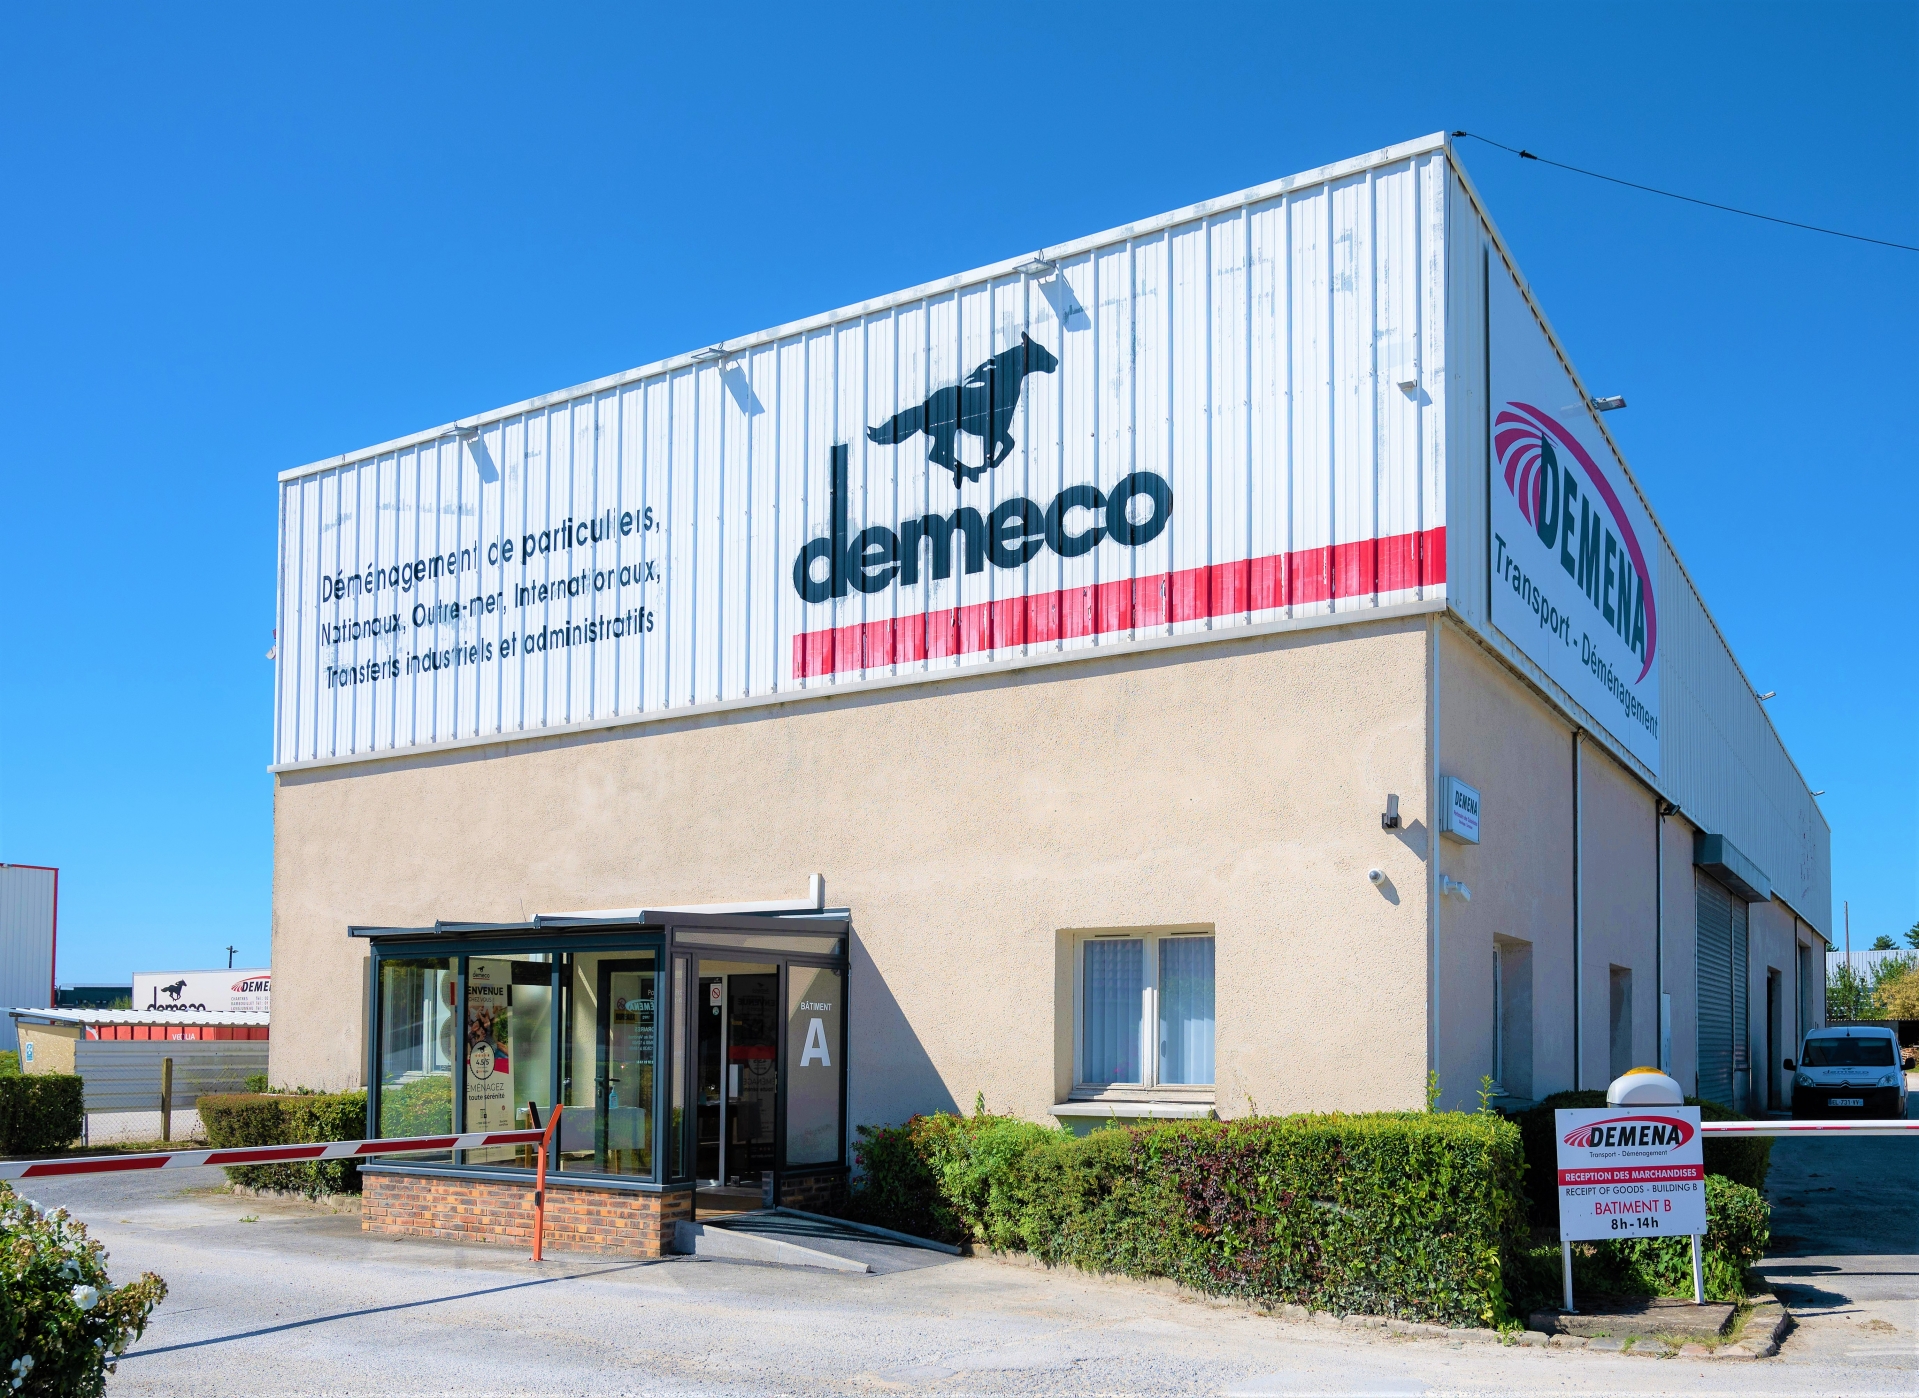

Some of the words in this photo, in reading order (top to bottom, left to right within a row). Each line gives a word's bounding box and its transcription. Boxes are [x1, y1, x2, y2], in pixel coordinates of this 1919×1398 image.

[793, 444, 1173, 604] demeco
[1537, 432, 1646, 666] DEMENA
[322, 540, 478, 603] Déménagement
[487, 534, 514, 566] de
[321, 613, 406, 647] Nationaux,
[412, 591, 507, 628] Outre-mer,
[500, 631, 517, 659] et
[524, 606, 654, 655] administratifs
[1494, 532, 1570, 647] Transport
[1581, 631, 1658, 741] Déménagement
[1454, 790, 1478, 817] DEMENA
[800, 1001, 832, 1011] BÂTIMENT
[800, 1018, 832, 1066] A
[467, 1082, 504, 1092] ÉMÉNAGEZ
[1589, 1125, 1680, 1148] DEMENA
[1565, 1171, 1612, 1182] RECEPTION
[1613, 1171, 1629, 1180] DES
[1632, 1168, 1697, 1179] MARCHANDISES
[1566, 1187, 1596, 1196] RECEIPT
[1599, 1186, 1610, 1195] OF
[1613, 1185, 1644, 1194] GOODS
[1652, 1183, 1690, 1193] BUILDING
[1595, 1200, 1659, 1215] BATIMENT
[1664, 1199, 1672, 1212] B
